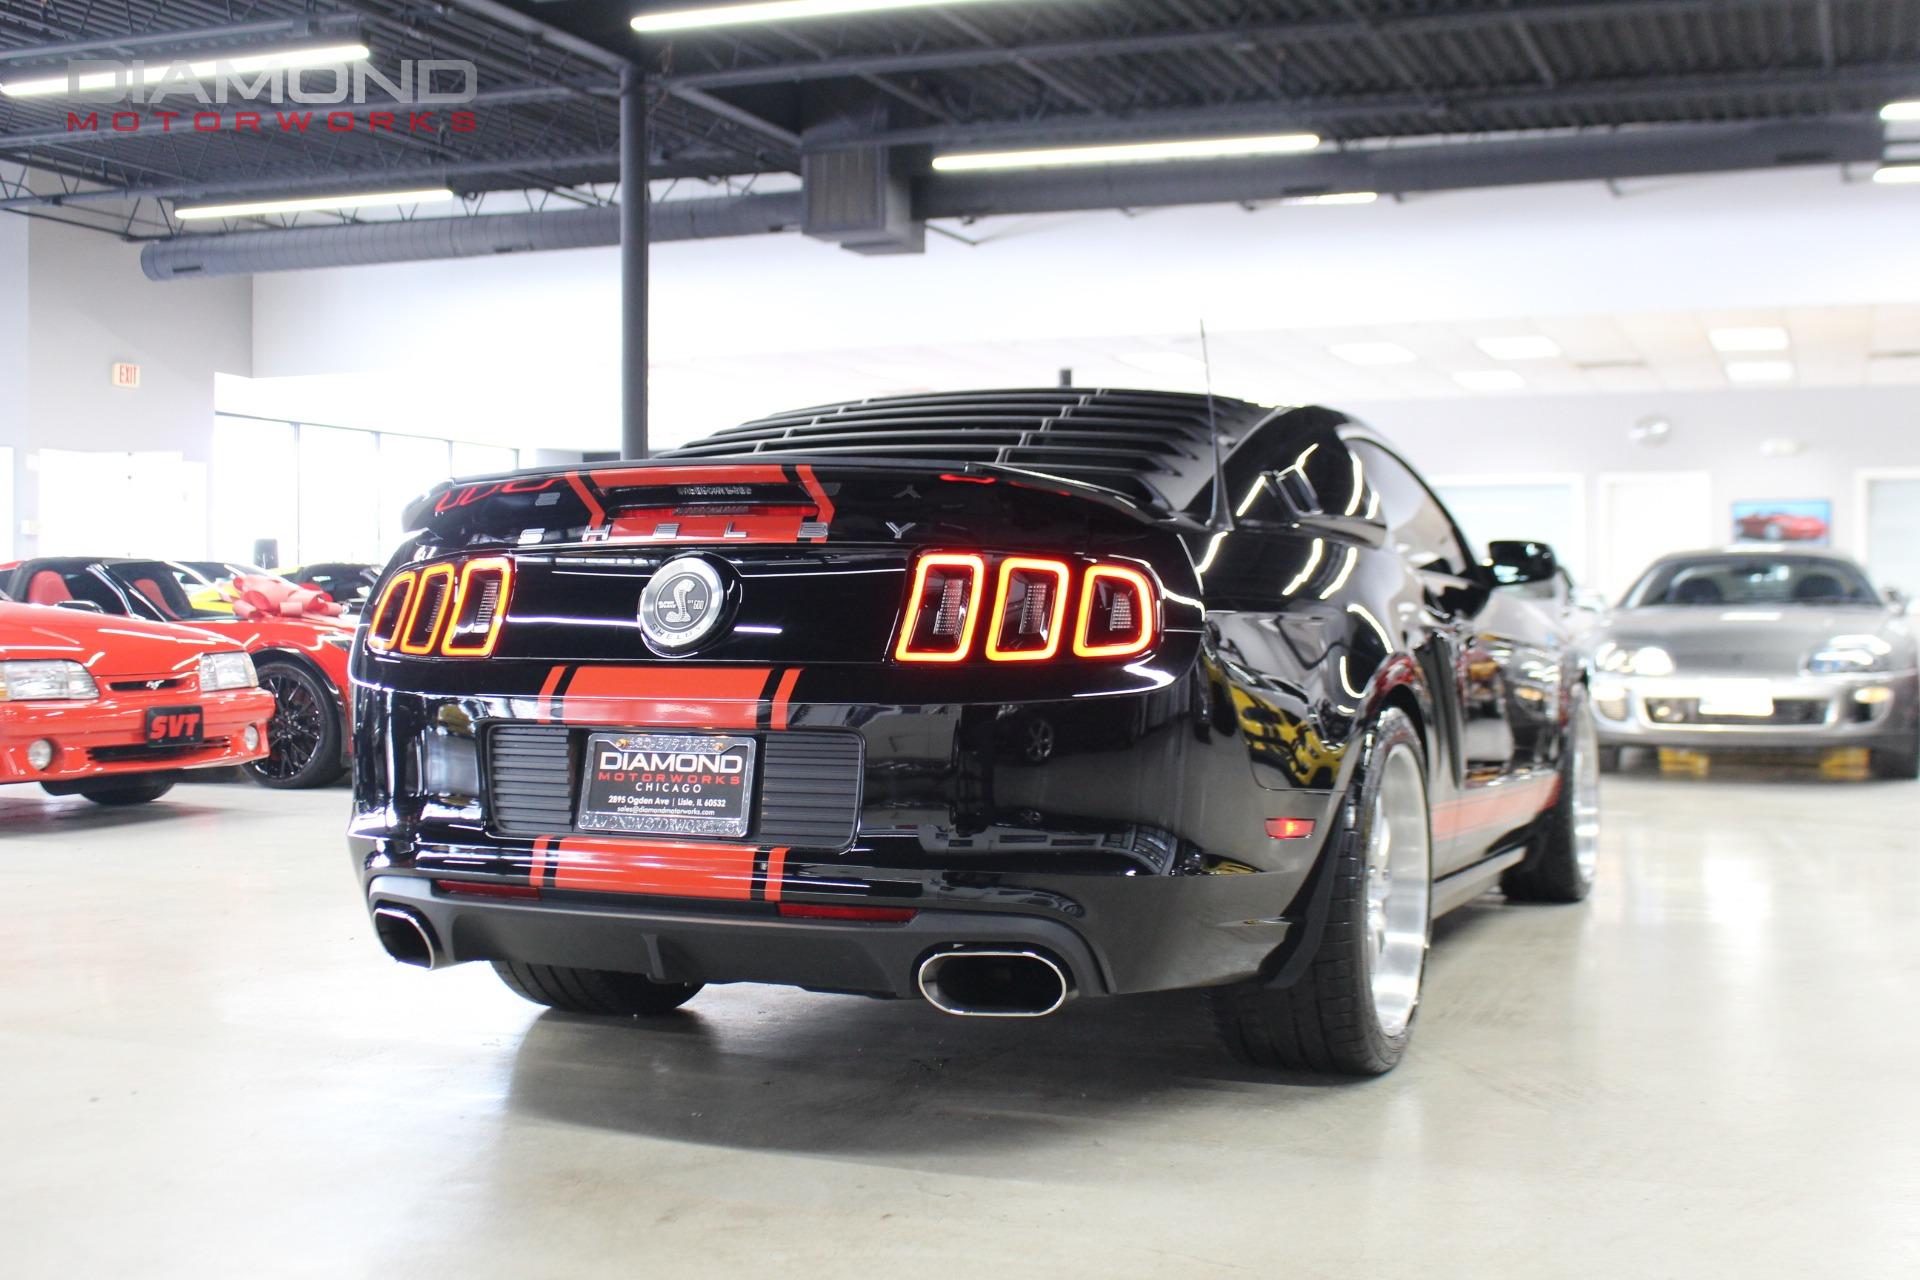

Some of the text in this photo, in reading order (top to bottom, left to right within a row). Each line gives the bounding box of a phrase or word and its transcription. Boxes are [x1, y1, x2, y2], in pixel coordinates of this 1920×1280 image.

[119, 364, 137, 384] EXIT
[517, 521, 917, 545] SHELBY
[150, 713, 201, 740] SVT
[600, 752, 743, 774] DIAMOND
[598, 772, 741, 785] MOTORWORKS
[635, 782, 702, 794] CHICAGO
[608, 795, 626, 804] 2895
[627, 796, 654, 806] Ogden
[655, 797, 670, 806] Ave
[677, 798, 695, 807] Lisle,
[696, 798, 703, 807] IL
[704, 799, 727, 808] 60532
[617, 805, 715, 816] sales@diamondmotorworks.com
